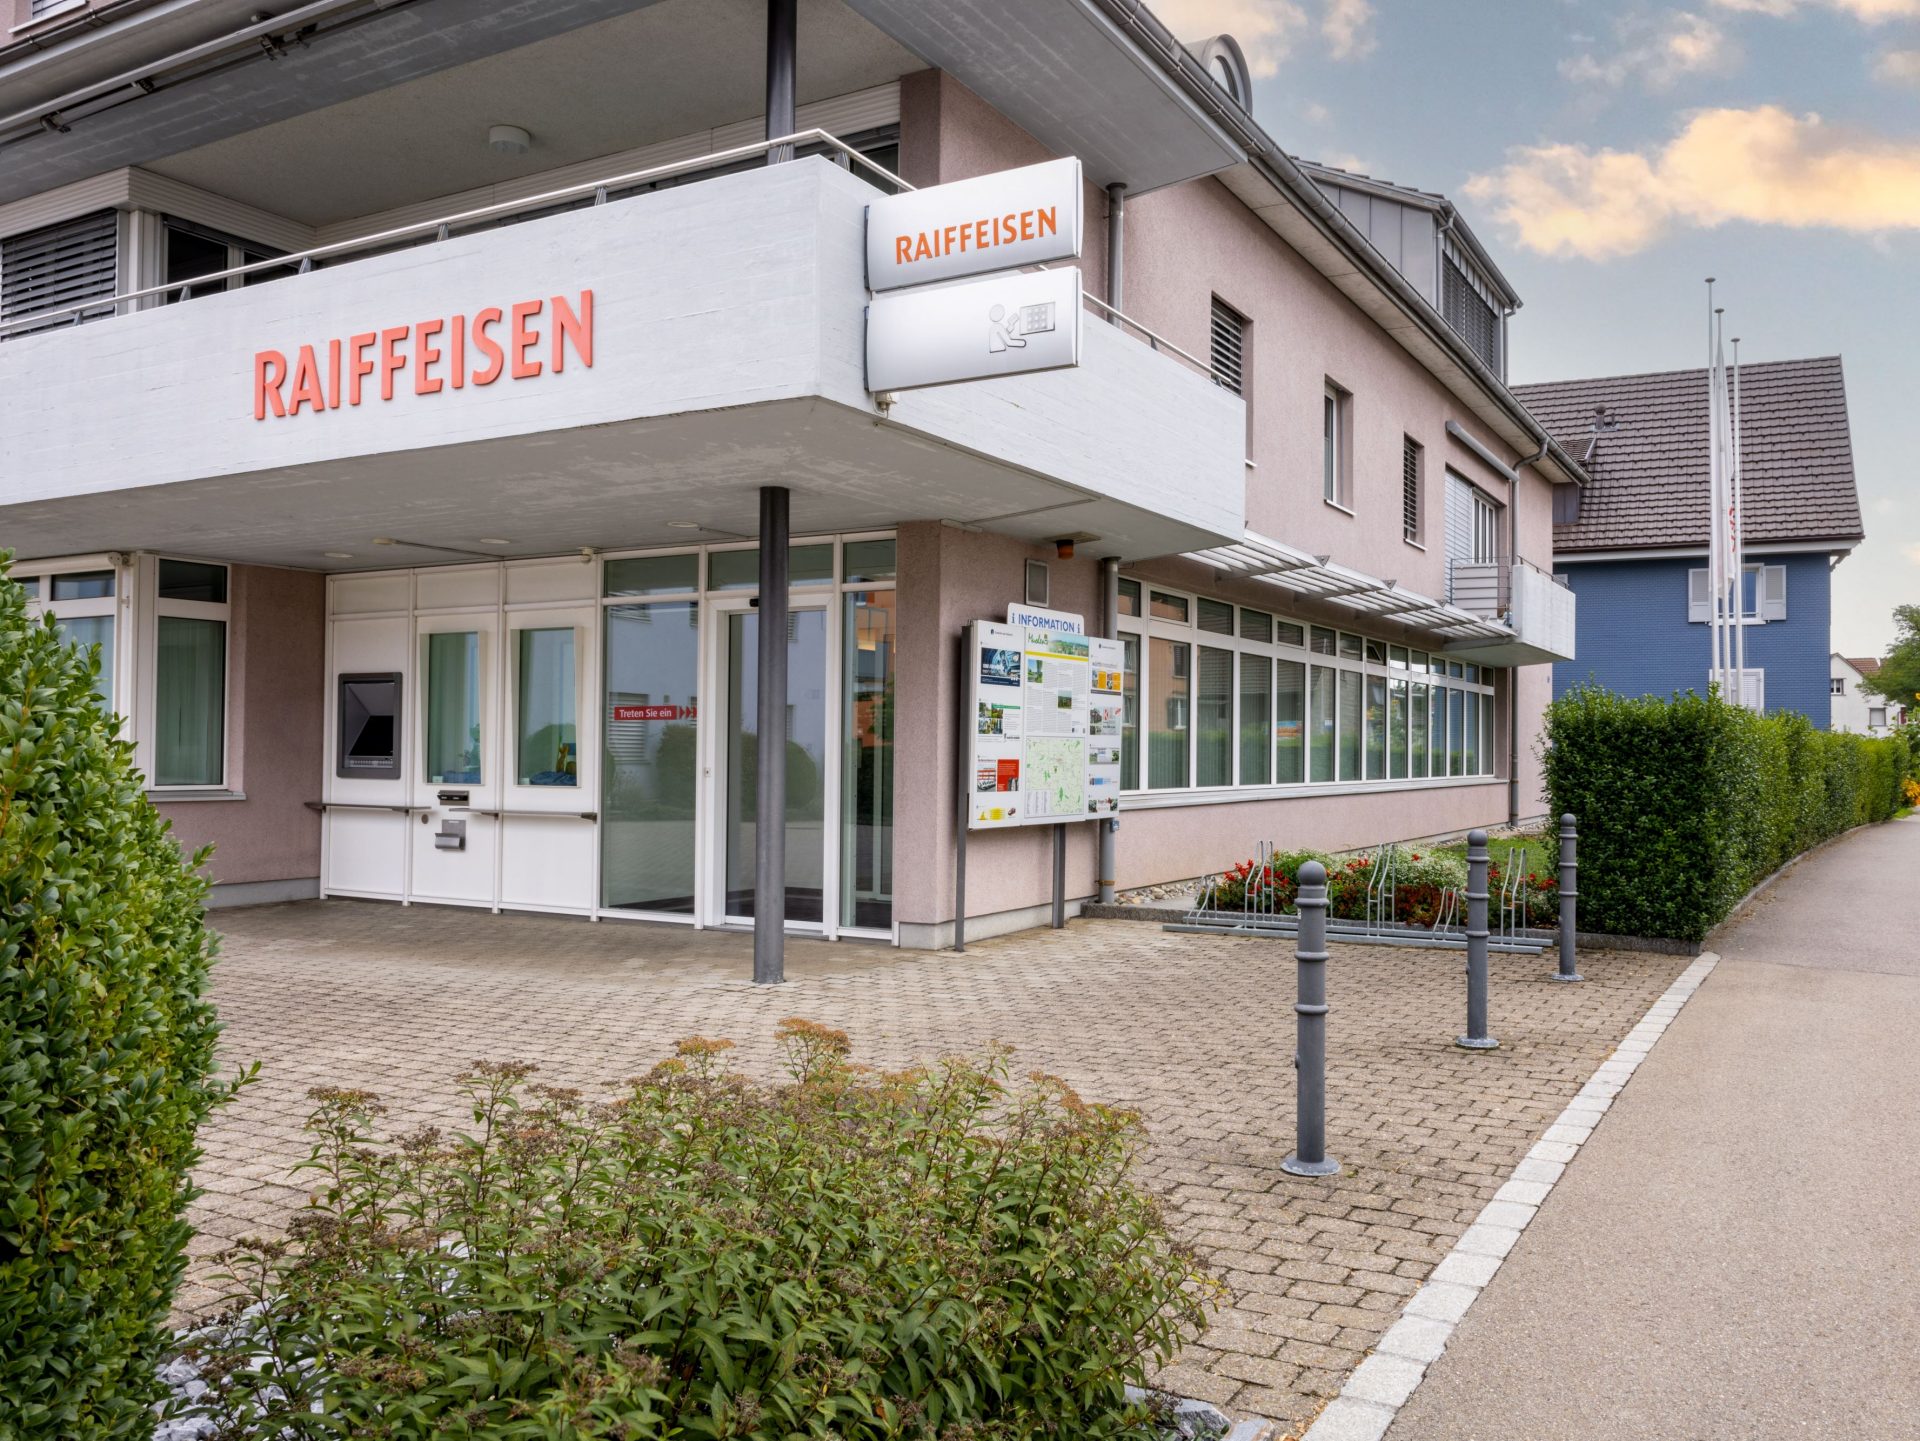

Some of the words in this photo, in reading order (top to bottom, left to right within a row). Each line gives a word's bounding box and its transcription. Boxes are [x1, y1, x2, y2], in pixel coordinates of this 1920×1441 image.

[895, 206, 1057, 265] RAIFFEISEN
[254, 289, 594, 421] RAIFFEISEN
[1018, 613, 1075, 633] INFORMATION
[619, 709, 644, 718] Treten
[645, 708, 658, 718] Sie
[659, 708, 672, 717] ein
